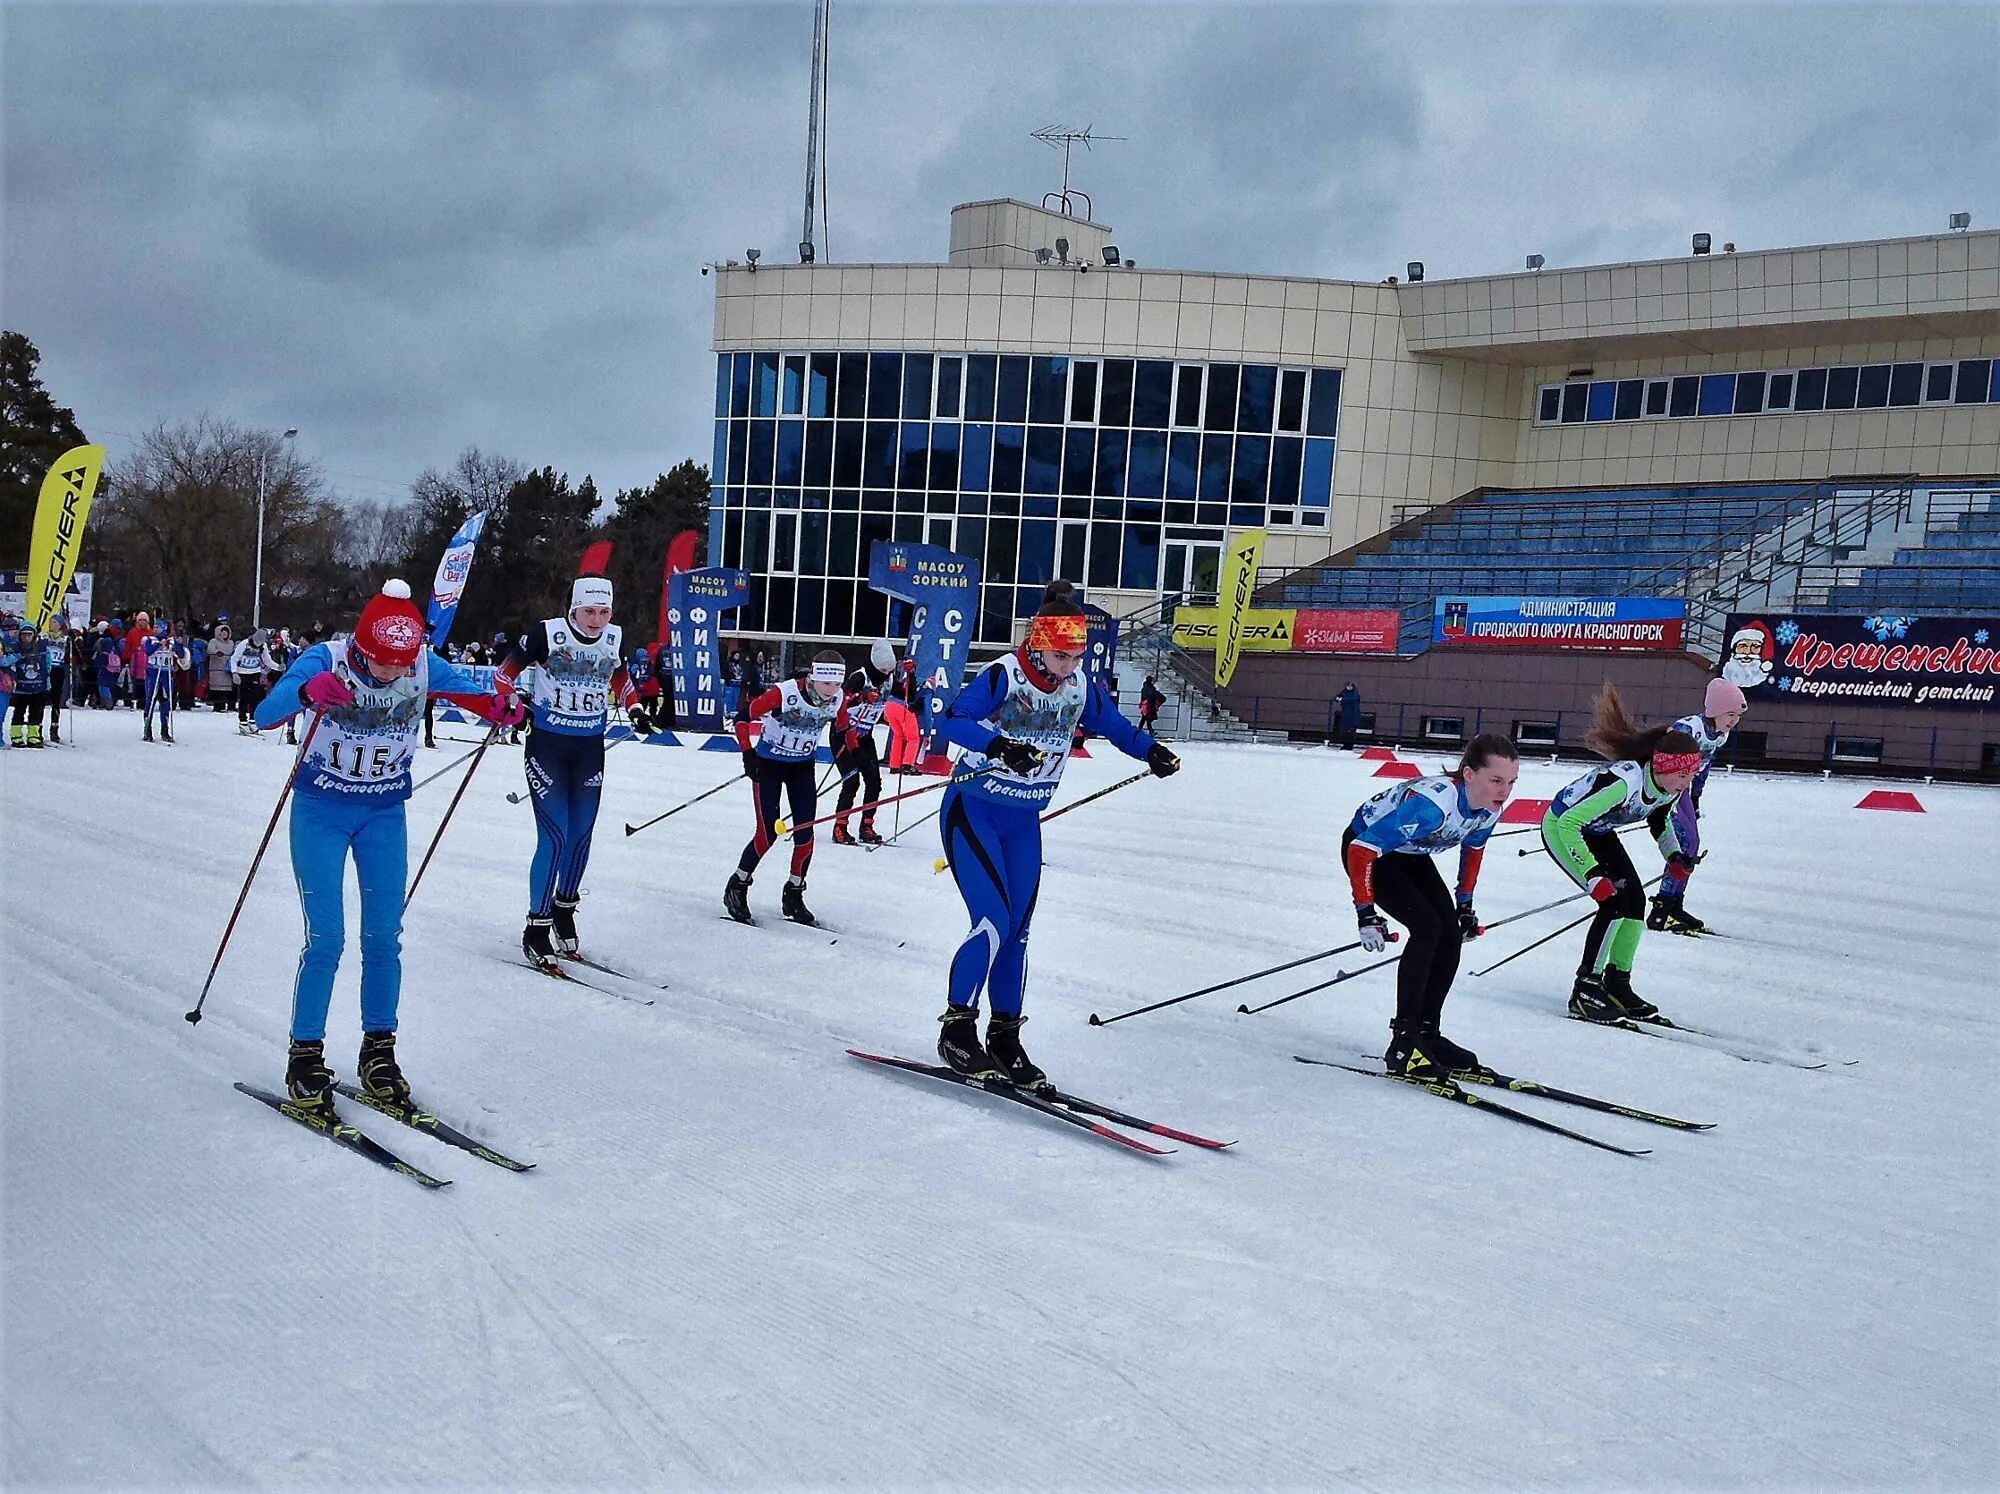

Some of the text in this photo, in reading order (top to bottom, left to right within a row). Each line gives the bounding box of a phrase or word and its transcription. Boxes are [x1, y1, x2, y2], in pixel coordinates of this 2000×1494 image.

[36, 490, 80, 632] FISCHER
[917, 561, 965, 574] МАСОУ
[691, 575, 726, 586] МАСОУ
[911, 574, 969, 588] ЗОРКИЙ
[687, 585, 729, 597] ЗОРКИЙ
[1519, 601, 1616, 618] АДМИНИСТРАЦИЯ
[1172, 623, 1270, 639] FISCER
[1218, 567, 1250, 680] FISCHER
[1472, 621, 1664, 641] ГОРОДСКОГО ОКРУГА КРАСНОГОРСК
[668, 607, 689, 717] ФИНИШ
[690, 607, 716, 716] ФИНИШ
[931, 609, 964, 714] СТАР
[1790, 676, 1995, 704] Всероссийский детский
